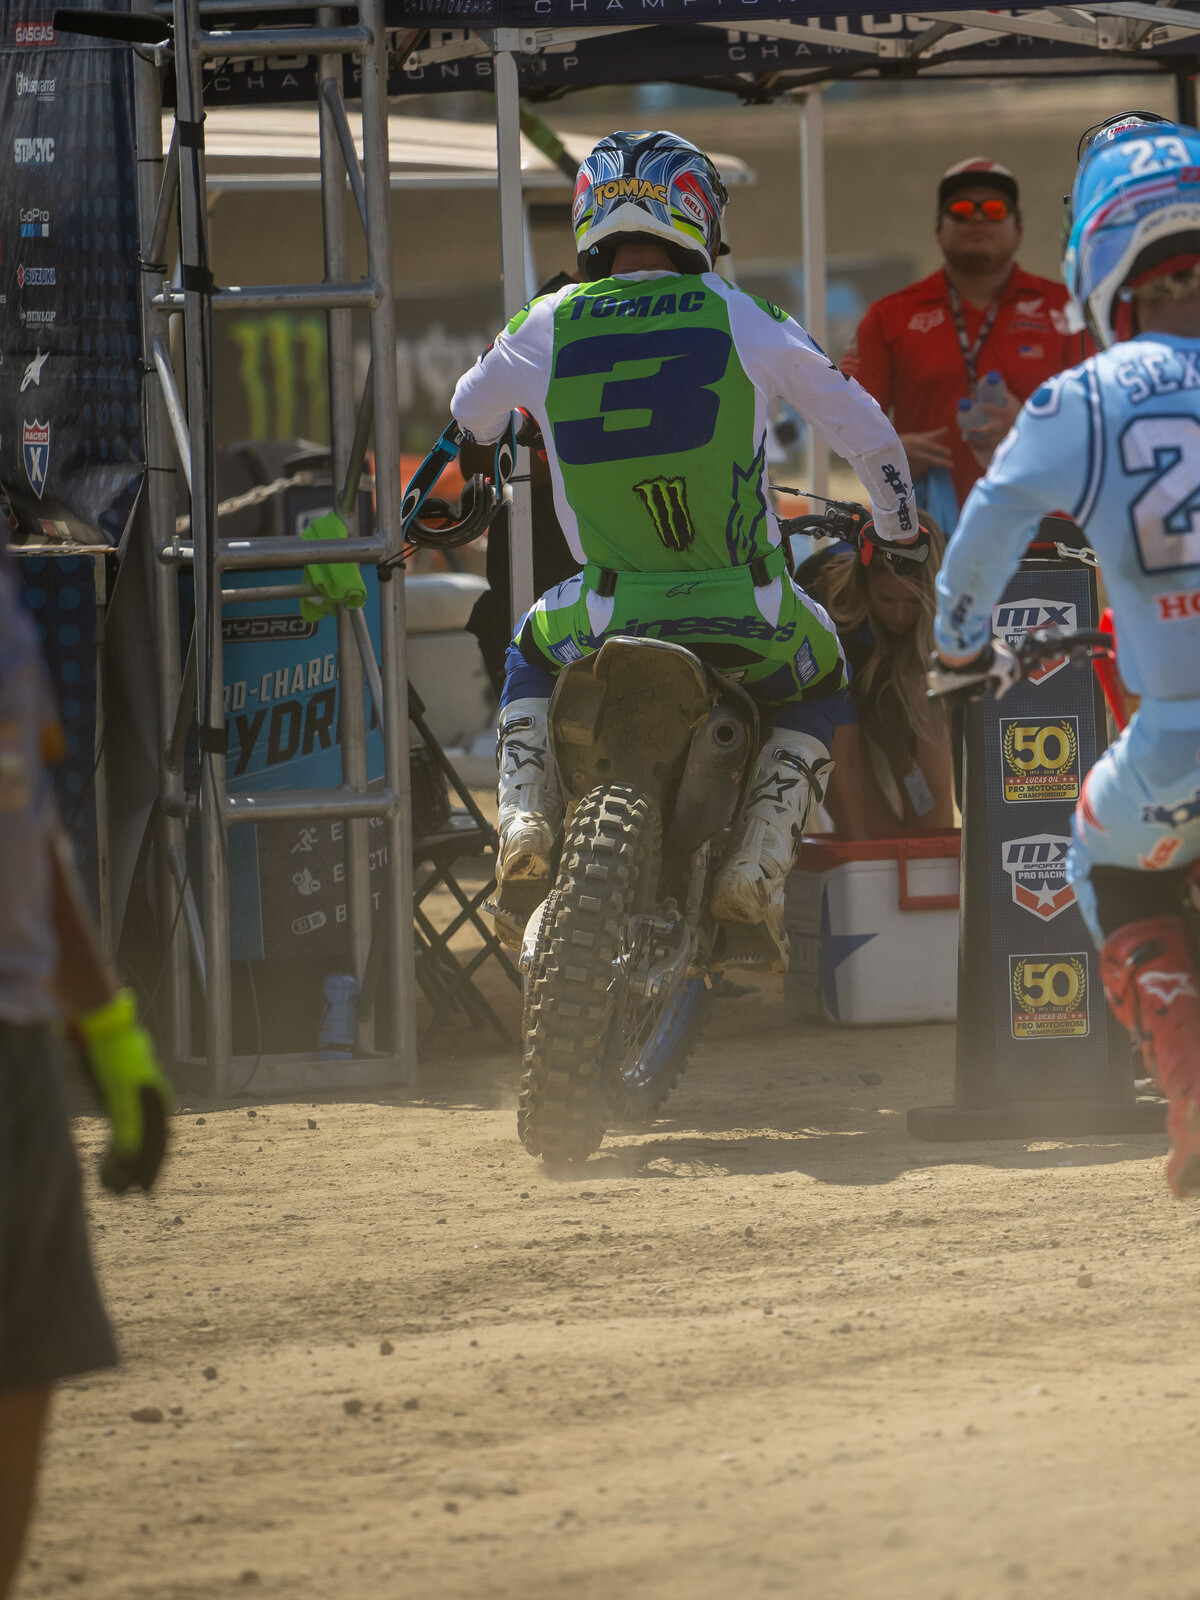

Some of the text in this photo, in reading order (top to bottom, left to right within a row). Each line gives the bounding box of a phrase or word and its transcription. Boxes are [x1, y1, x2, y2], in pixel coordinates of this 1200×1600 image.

[16, 26, 55, 43] GASGAS
[15, 138, 55, 163] STACYC
[594, 178, 669, 208] TOMAC
[20, 208, 50, 222] GoPro
[682, 195, 703, 219] BELL
[25, 267, 57, 285] SUZUKI
[570, 290, 706, 321] TOMAC
[26, 311, 57, 322] DUNLOP
[553, 326, 733, 466] 3
[25, 432, 48, 441] RACER
[30, 447, 43, 482] X
[1013, 726, 1070, 770] 50
[1027, 783, 1076, 792] MOTOCROSS
[1018, 870, 1066, 879] PRO RACIN
[1022, 962, 1079, 1007] 50
[1035, 1020, 1085, 1029] MOTOCROSS
